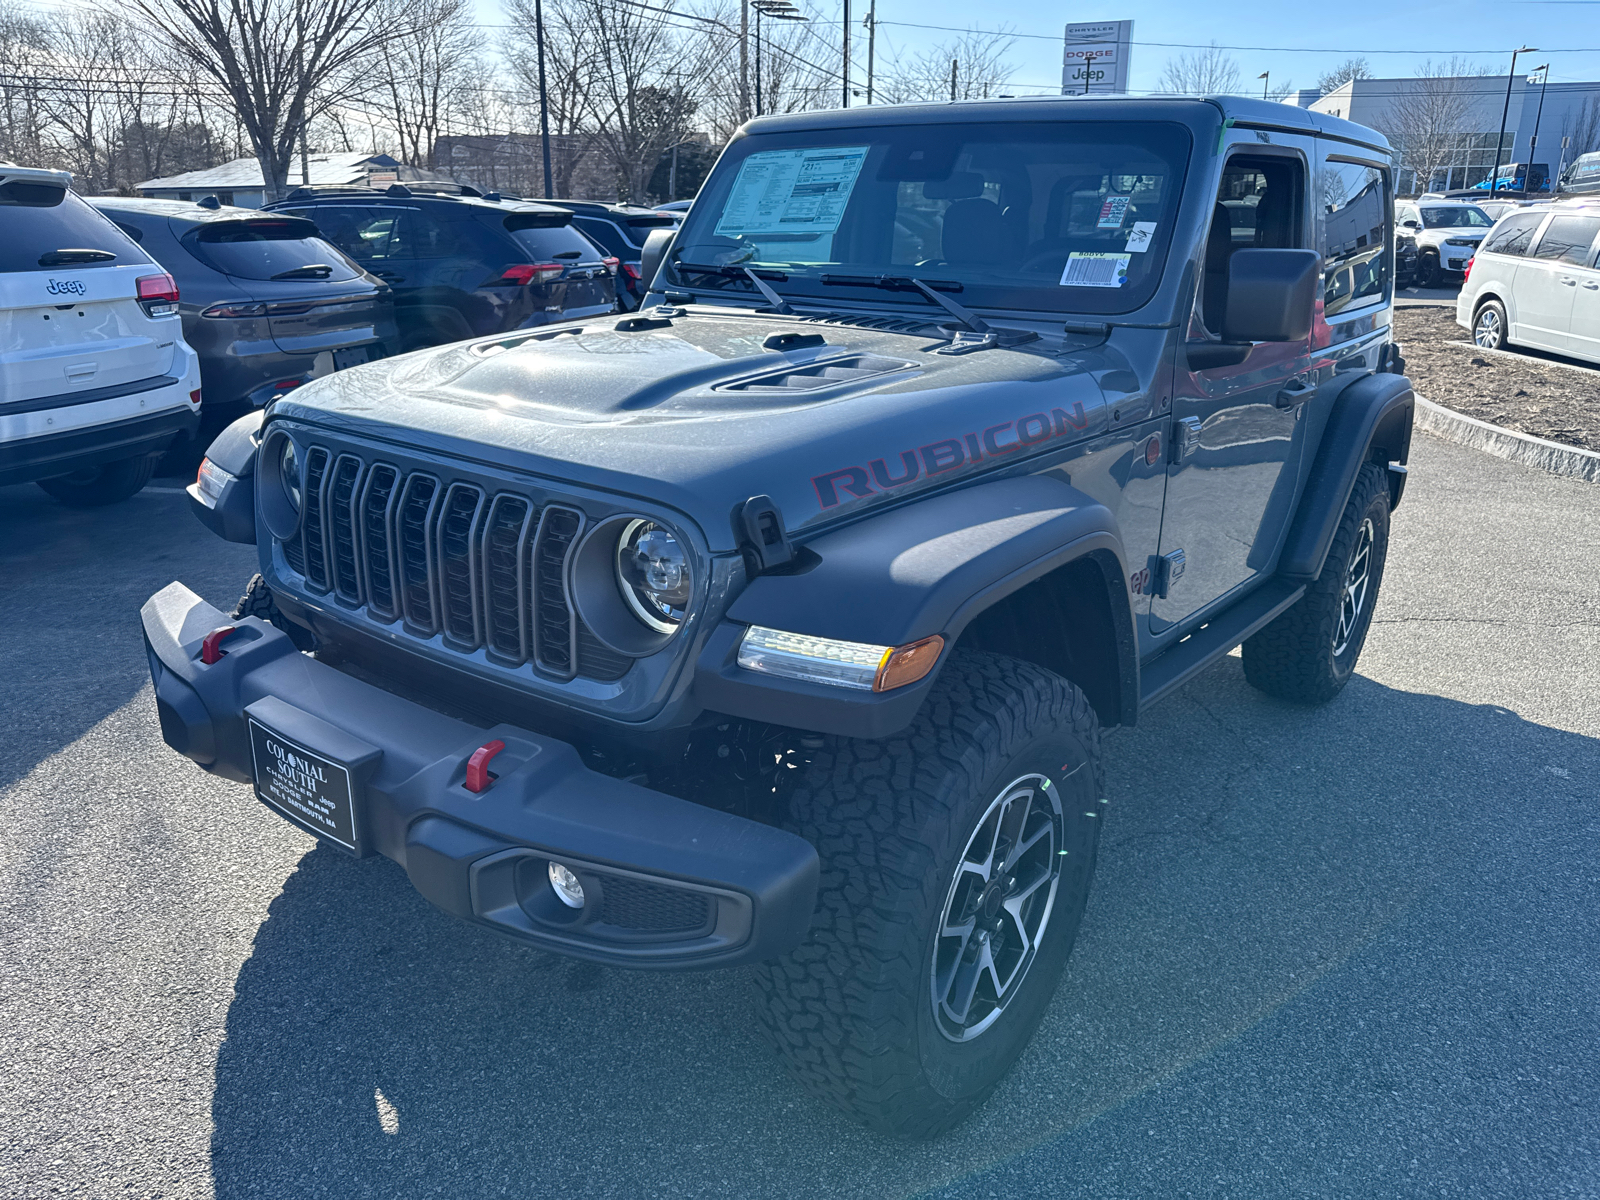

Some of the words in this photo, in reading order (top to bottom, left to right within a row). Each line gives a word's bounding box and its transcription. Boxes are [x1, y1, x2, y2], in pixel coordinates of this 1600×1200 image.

[1066, 50, 1114, 58] DODGE
[1072, 68, 1105, 82] Jeep
[46, 278, 86, 296] Jeep
[810, 401, 1088, 510] RUBICON
[266, 739, 328, 783] COLONIAL
[277, 759, 317, 793] SOUTH
[266, 766, 313, 798] CHRYSLER
[319, 795, 336, 810] Jeep
[272, 778, 302, 801] DODGE
[307, 800, 330, 815] RAM
[287, 796, 325, 824] DARTMOUTH,
[325, 817, 337, 829] MA
